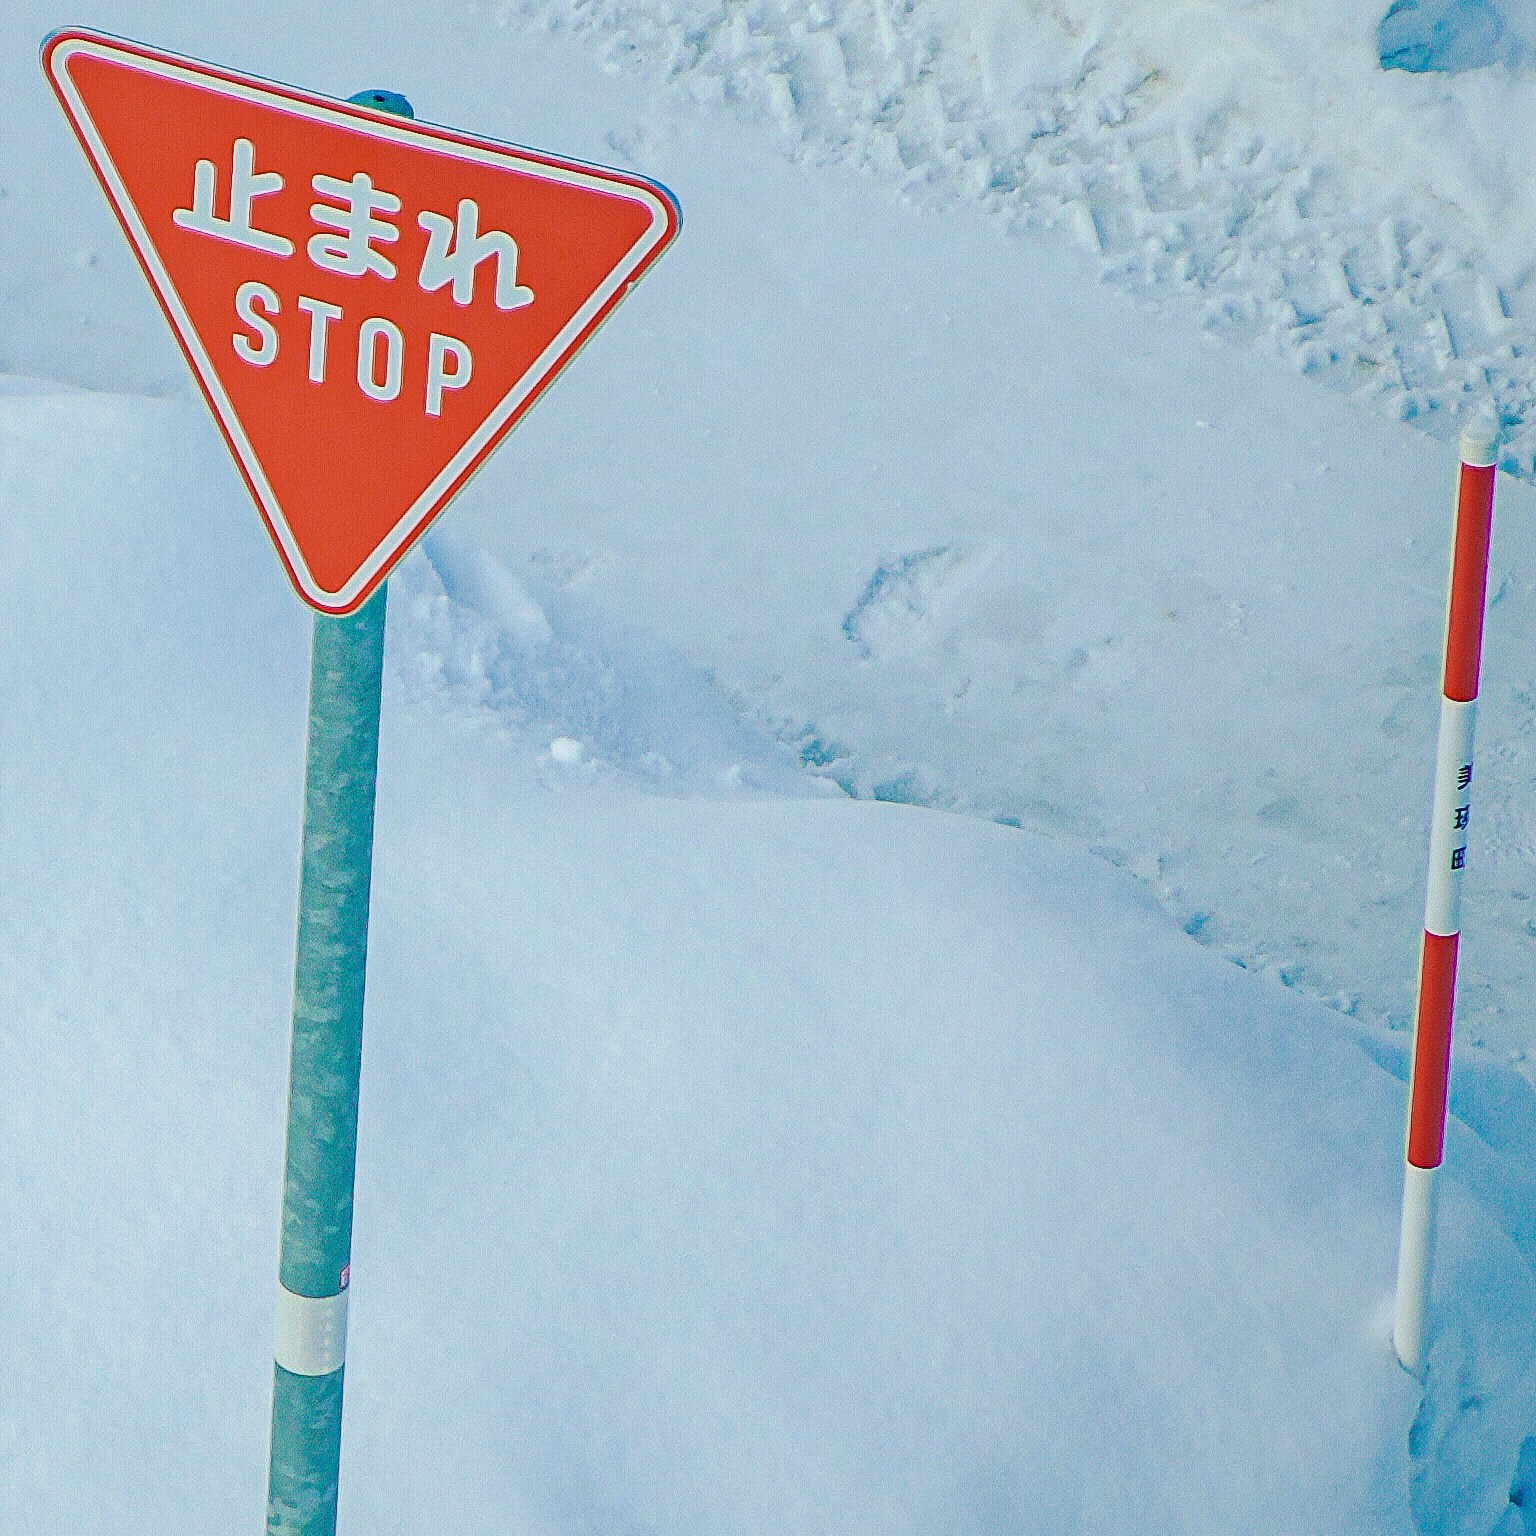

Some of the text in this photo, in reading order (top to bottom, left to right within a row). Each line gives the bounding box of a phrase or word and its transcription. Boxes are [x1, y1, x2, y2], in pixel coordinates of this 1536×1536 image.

[172, 138, 535, 311] 止まれ
[232, 281, 473, 416] STOP
